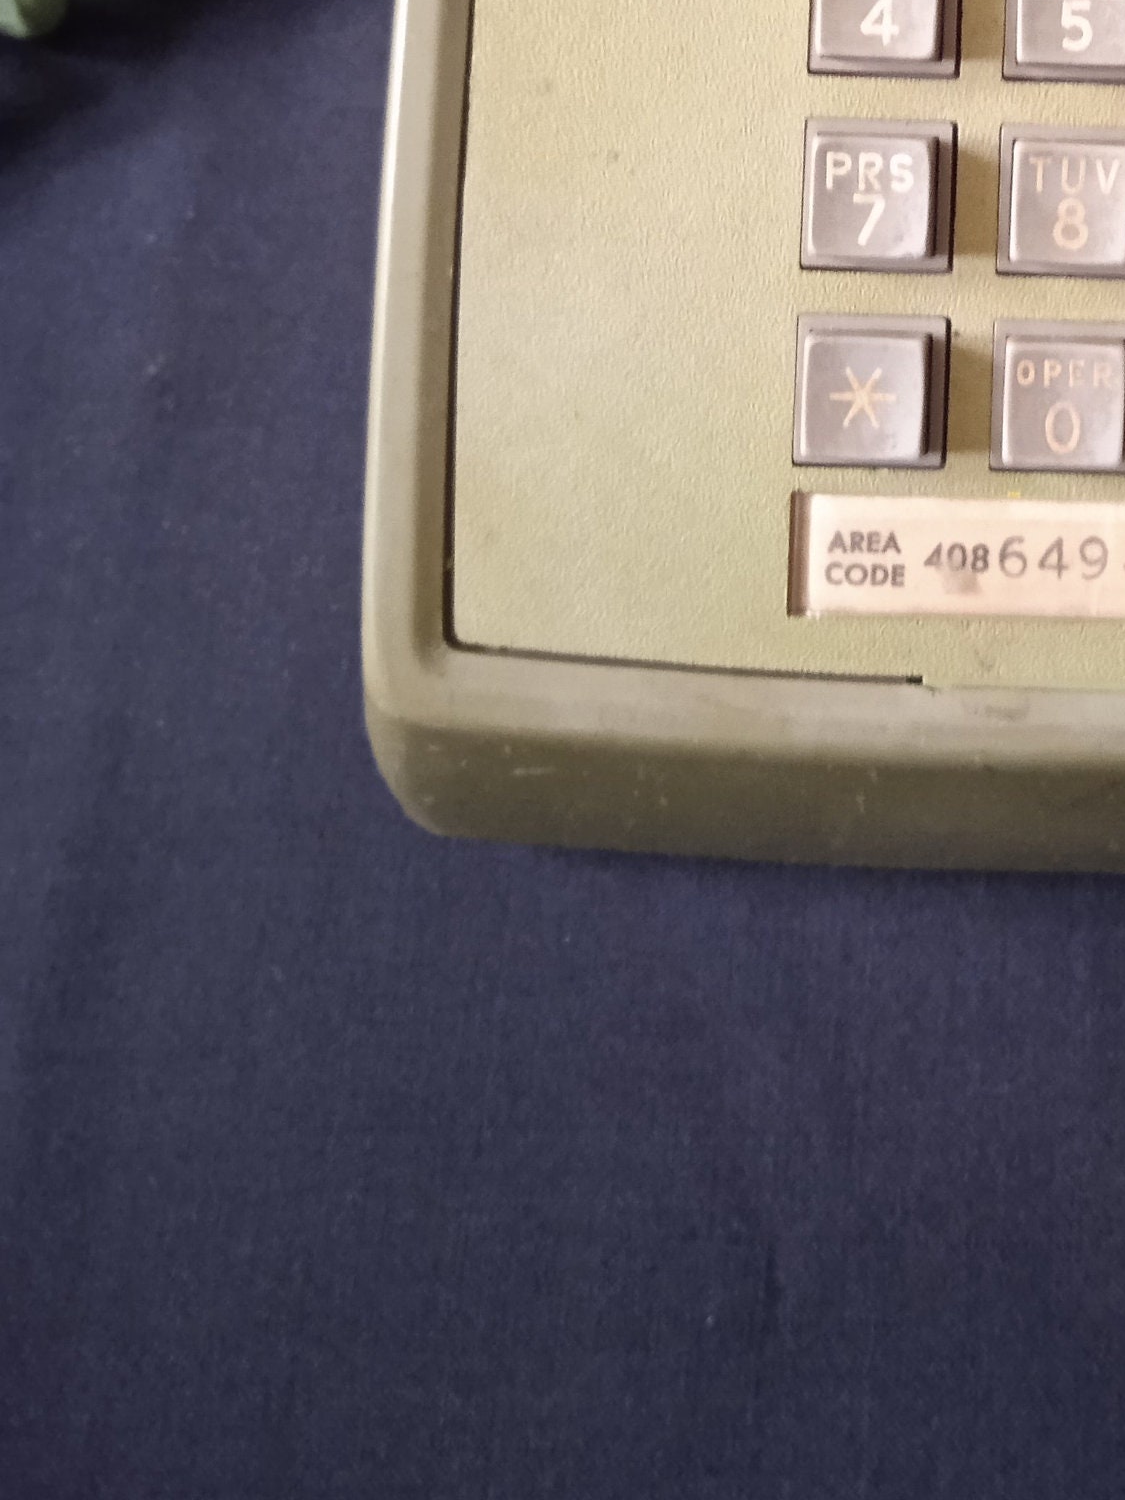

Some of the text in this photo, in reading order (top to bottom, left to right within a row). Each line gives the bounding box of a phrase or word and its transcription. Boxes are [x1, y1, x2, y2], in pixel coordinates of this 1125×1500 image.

[1060, 0, 1093, 52] 5
[825, 151, 915, 191] PRS
[1028, 156, 1120, 195] TUV
[852, 193, 885, 246] 7
[1052, 198, 1089, 251] 8
[1016, 359, 1116, 389] OPER
[828, 531, 902, 555] AREA
[923, 542, 990, 573] 408
[825, 562, 905, 588] CODE
